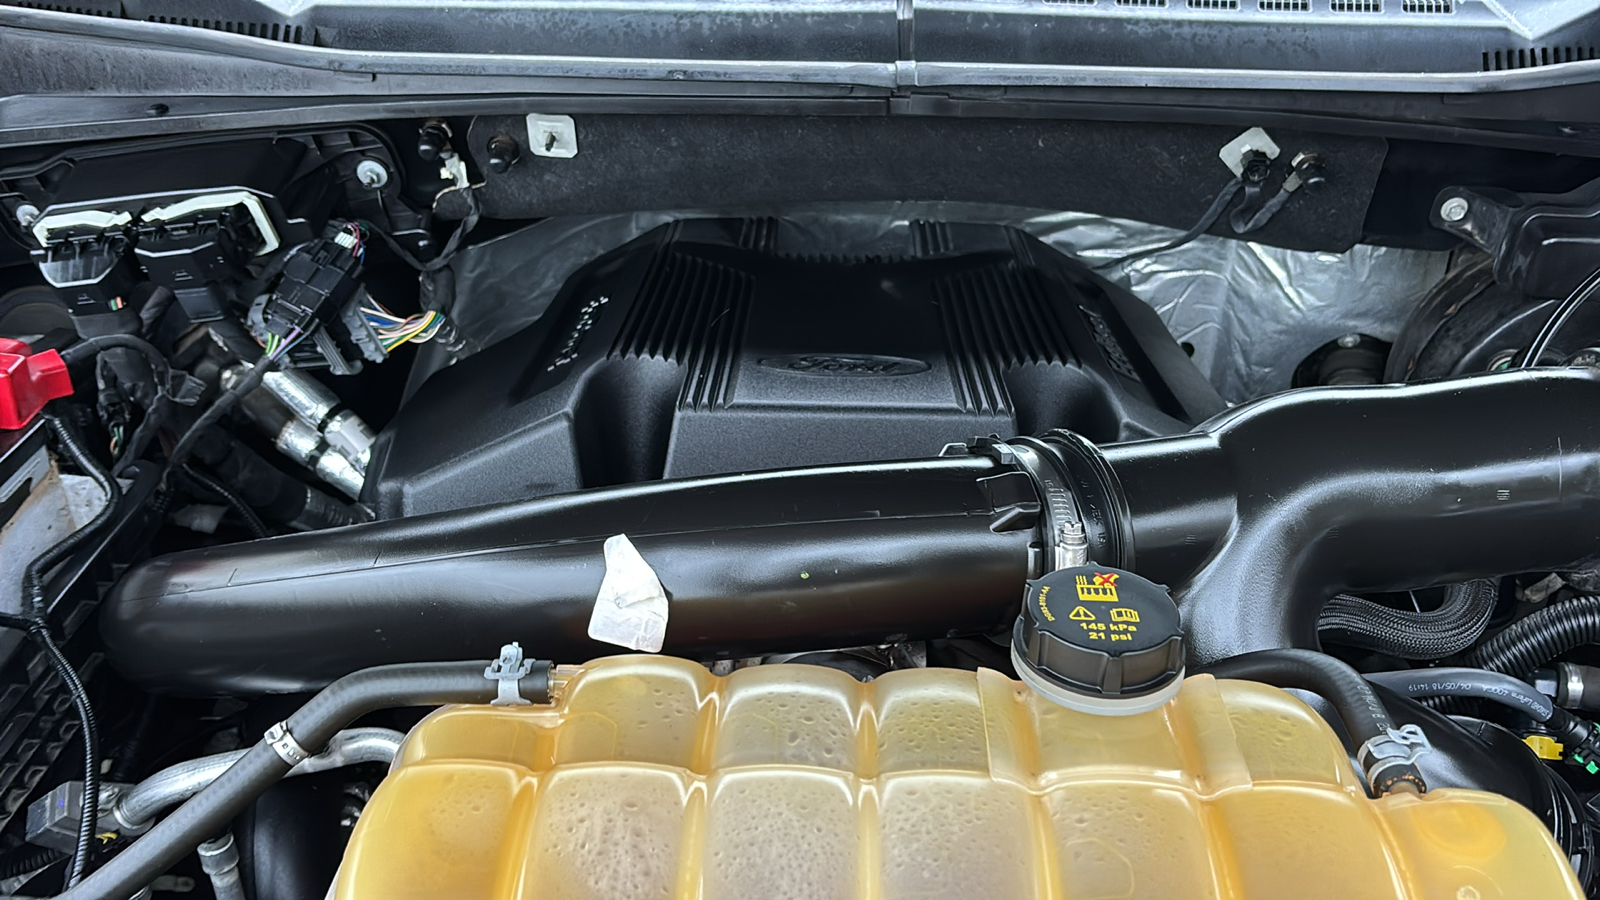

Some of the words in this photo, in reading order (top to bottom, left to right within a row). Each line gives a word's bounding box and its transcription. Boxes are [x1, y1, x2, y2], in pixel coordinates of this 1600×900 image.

[1080, 622, 1106, 631] 145
[1109, 623, 1138, 632] kPa
[1088, 631, 1106, 640] 21
[1110, 632, 1133, 642] psi
[1431, 682, 1472, 691] 04/05/18
